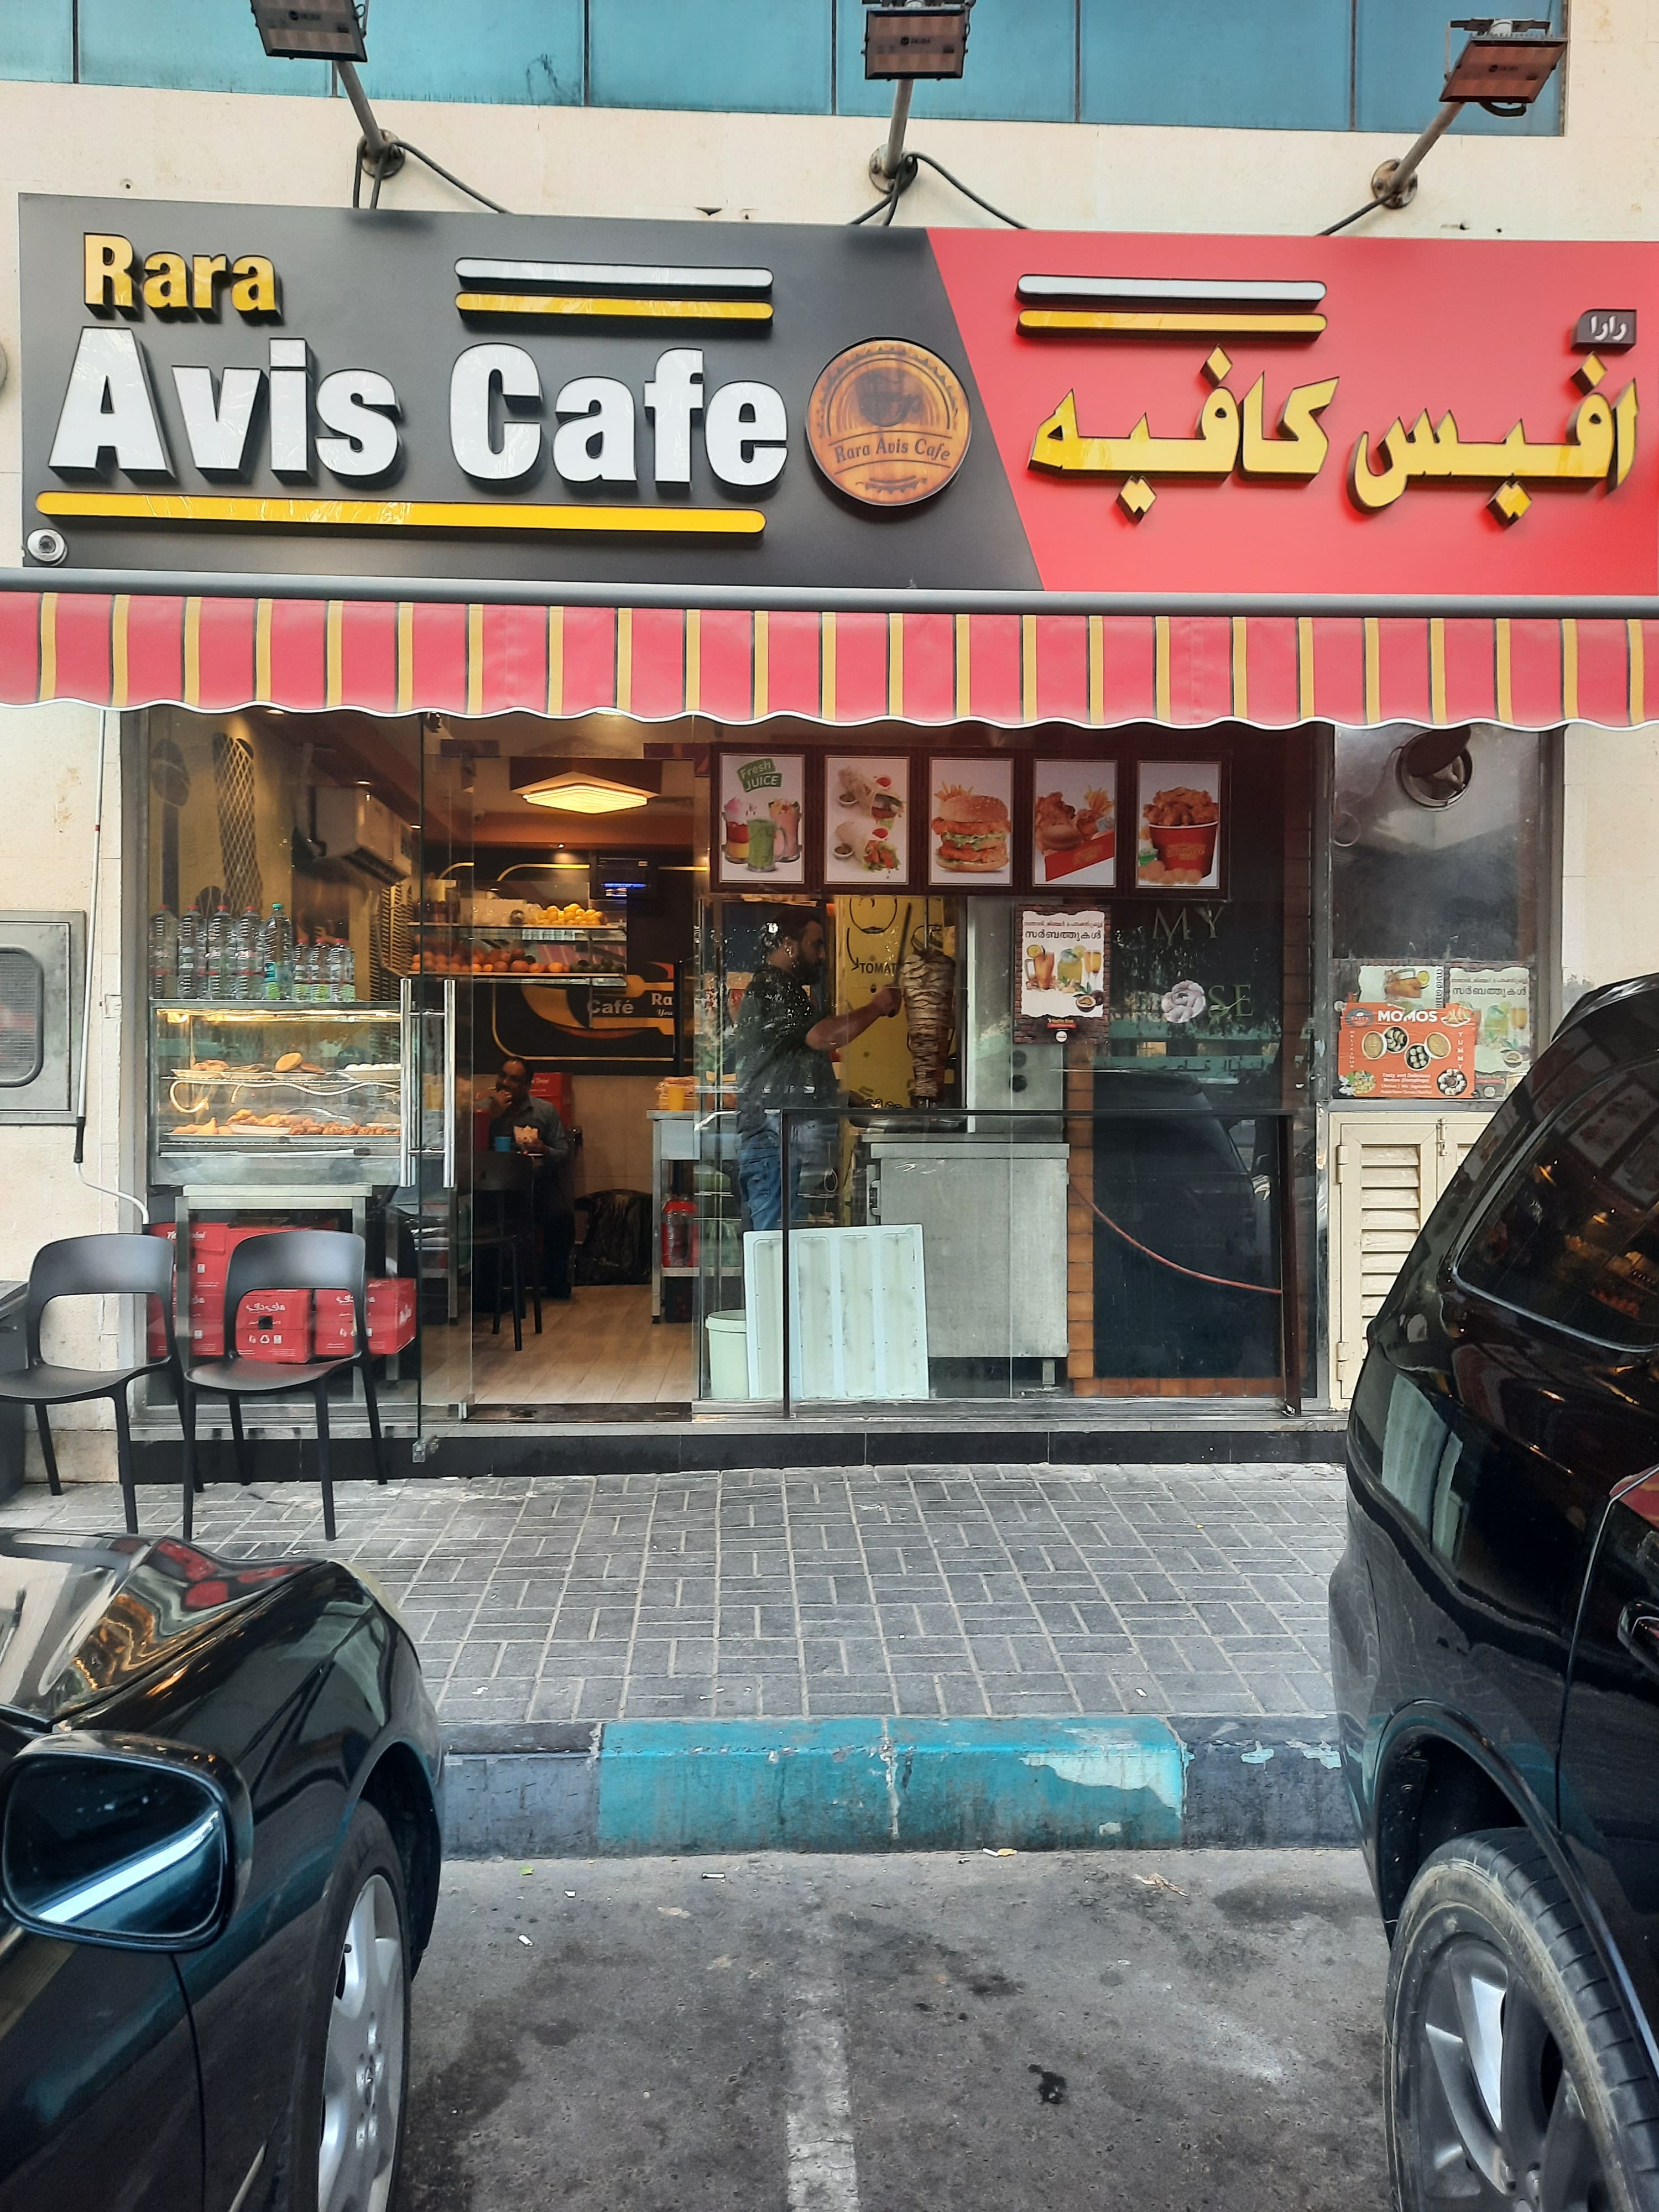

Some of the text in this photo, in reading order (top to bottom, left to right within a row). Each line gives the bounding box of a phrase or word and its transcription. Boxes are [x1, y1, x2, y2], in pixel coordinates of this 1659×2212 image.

[84, 232, 281, 322] Rara
[1590, 314, 1627, 341] رارا
[49, 326, 789, 488] Avis Cafe
[1029, 346, 1339, 522] كافيه
[834, 437, 951, 463] Rara Avis Cafe
[740, 761, 771, 779] Fresh
[746, 776, 779, 791] JUICE
[860, 962, 897, 973] TOMAT
[587, 999, 634, 1014] Café
[1378, 1010, 1438, 1022] MOMOS
